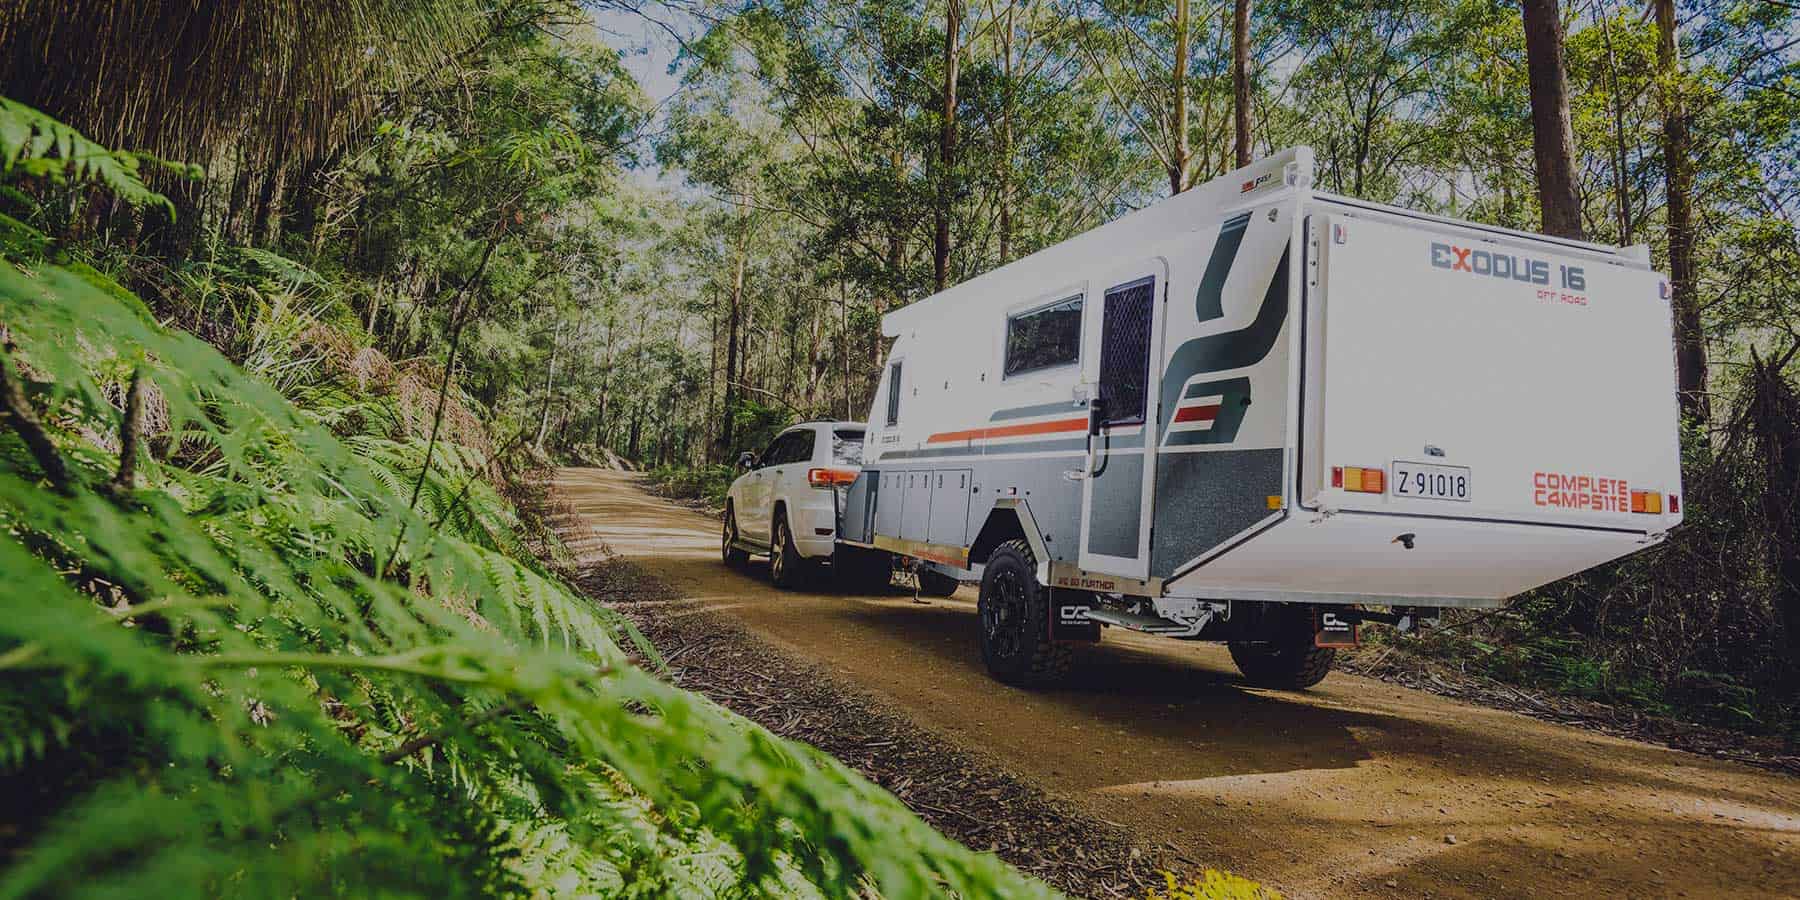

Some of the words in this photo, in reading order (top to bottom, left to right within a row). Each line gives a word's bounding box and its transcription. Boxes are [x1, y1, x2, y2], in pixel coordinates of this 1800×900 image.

[1431, 242, 1549, 285] EXODUS
[1560, 264, 1585, 291] 16
[1537, 290, 1556, 301] OFF
[1561, 293, 1587, 306] ROAD
[1534, 472, 1627, 496] COMPLETE
